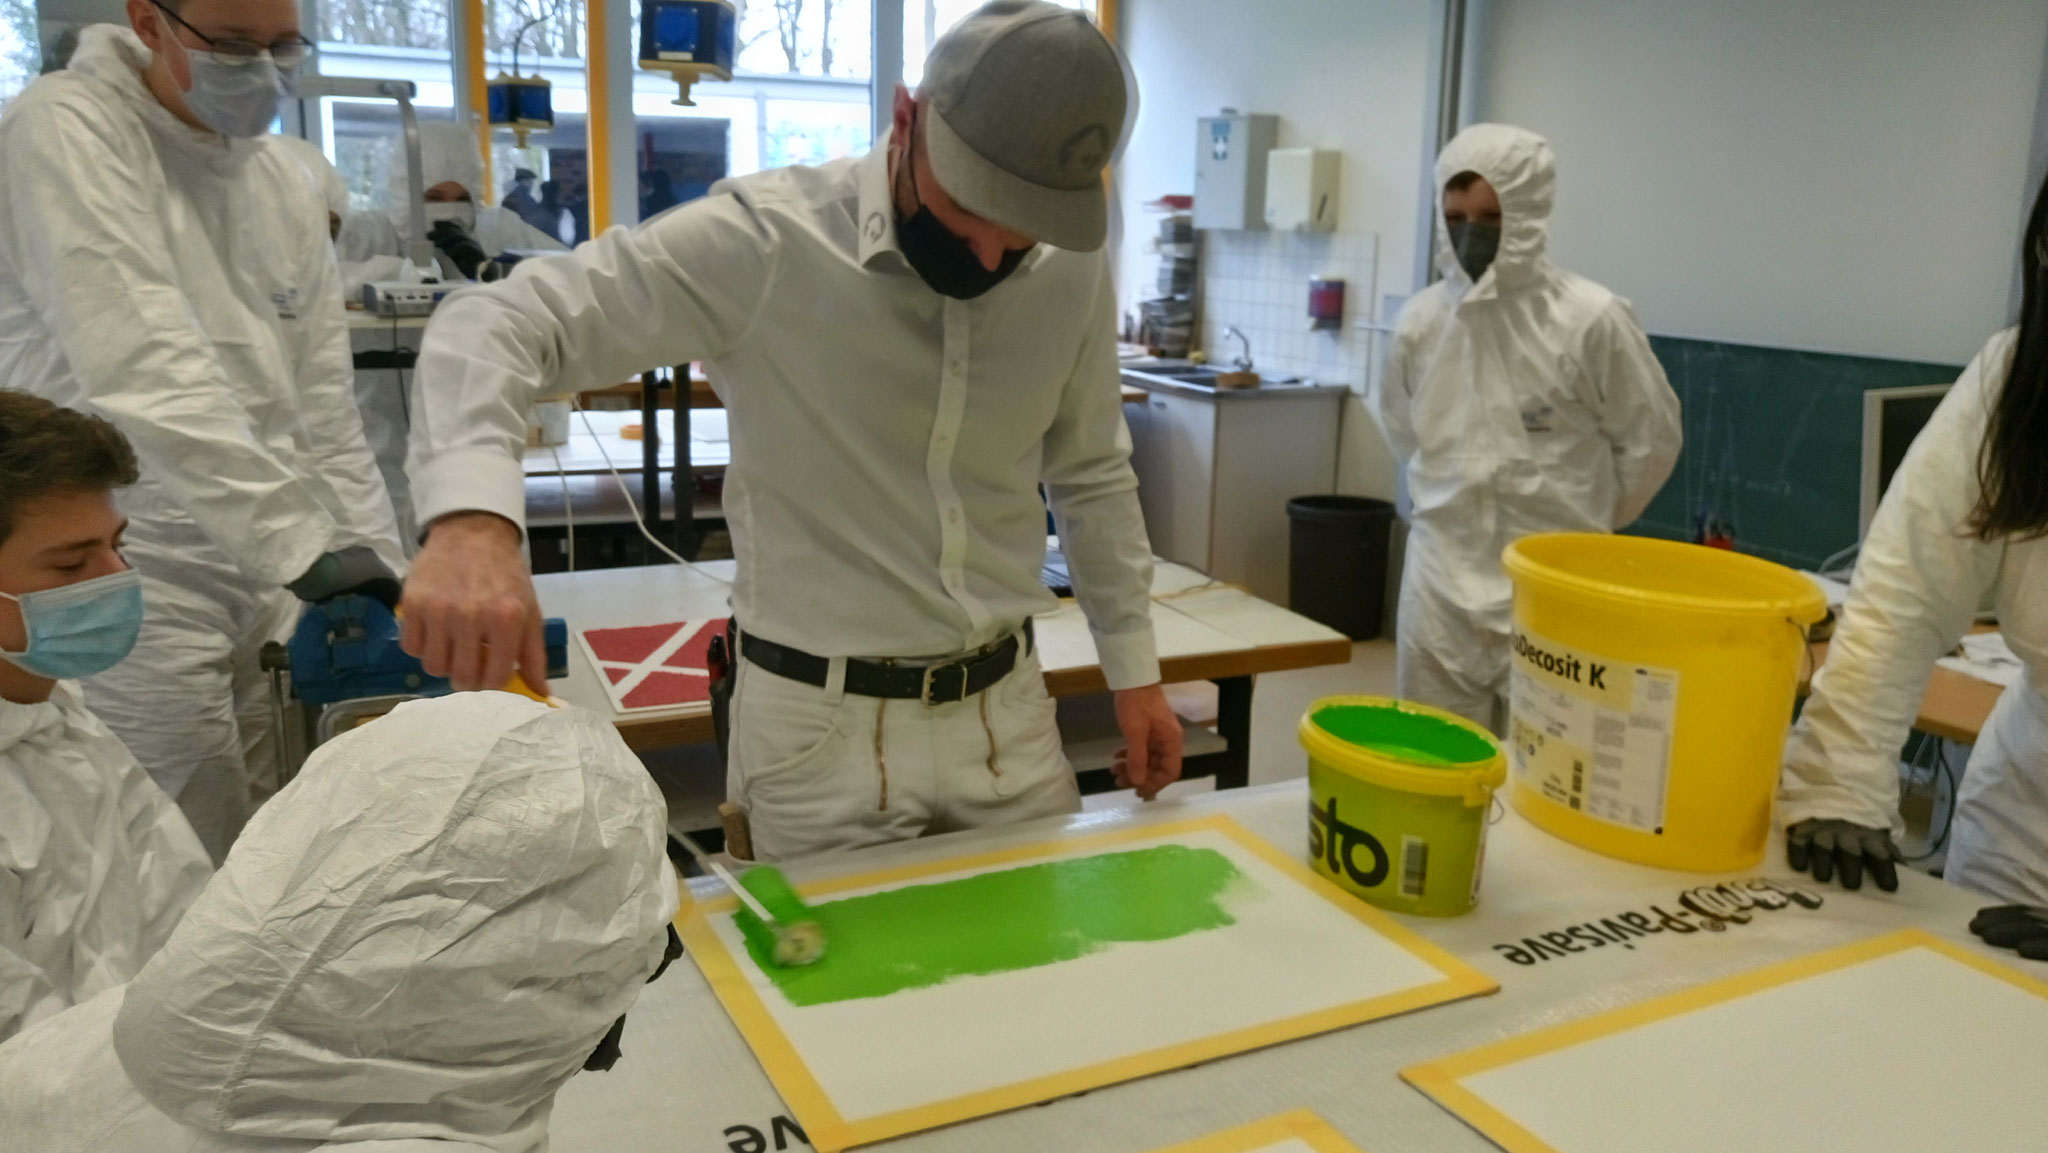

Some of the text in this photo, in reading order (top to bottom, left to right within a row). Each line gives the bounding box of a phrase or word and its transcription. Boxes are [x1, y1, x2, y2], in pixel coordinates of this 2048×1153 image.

[1589, 662, 1606, 690] K
[1308, 797, 1390, 887] sto
[723, 1115, 810, 1153] ve
